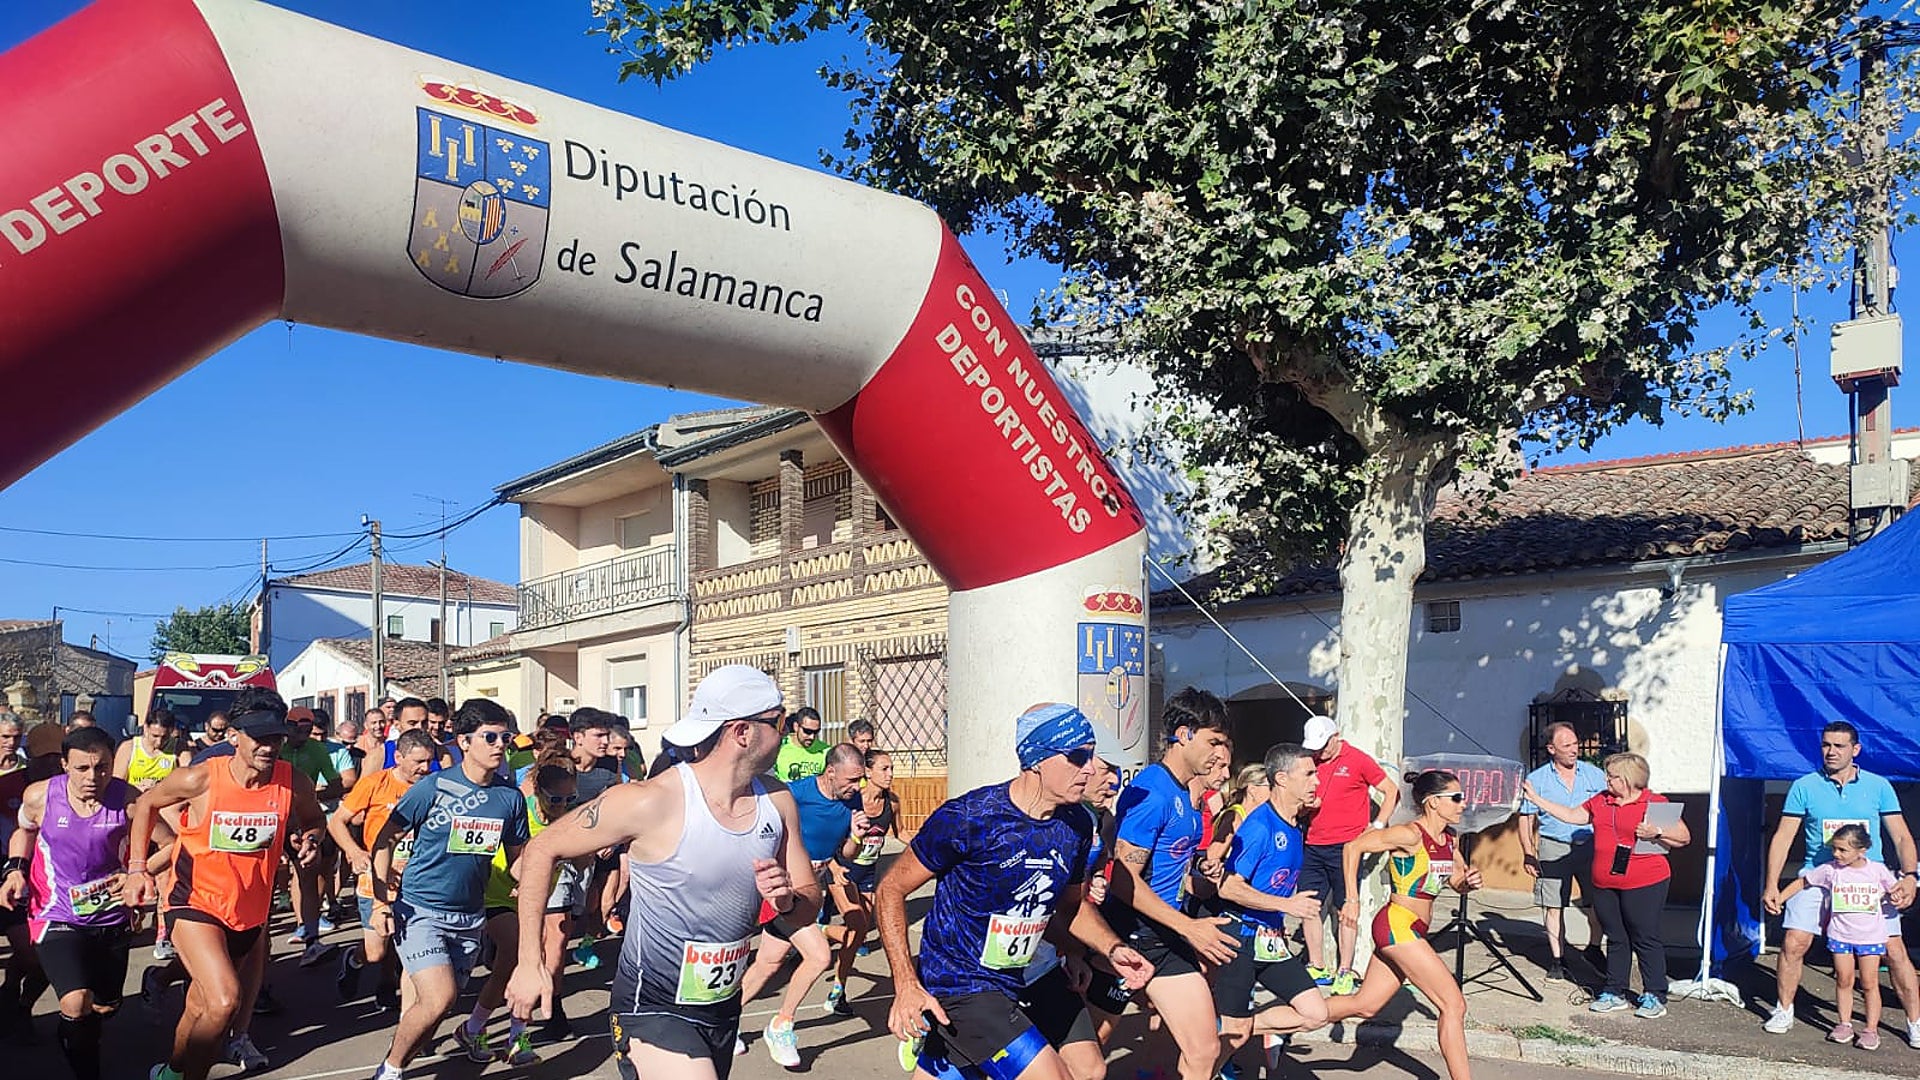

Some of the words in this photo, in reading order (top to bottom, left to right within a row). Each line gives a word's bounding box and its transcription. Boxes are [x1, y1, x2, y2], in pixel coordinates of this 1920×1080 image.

[0, 98, 248, 255] DEPORTE
[565, 140, 792, 232] Diputación
[557, 239, 596, 277] de
[614, 241, 824, 323] Salamanca
[955, 283, 1008, 358] CON
[1006, 358, 1122, 519] NUESTROS
[934, 323, 1092, 535] DEPORTISTAS
[213, 814, 277, 827] bedunia
[426, 790, 489, 831] adidas
[230, 827, 257, 843] 48
[453, 818, 502, 831] bedunia
[464, 831, 485, 845] 86
[1842, 893, 1870, 905] 103
[1007, 935, 1032, 957] 61
[707, 963, 737, 990] 23
